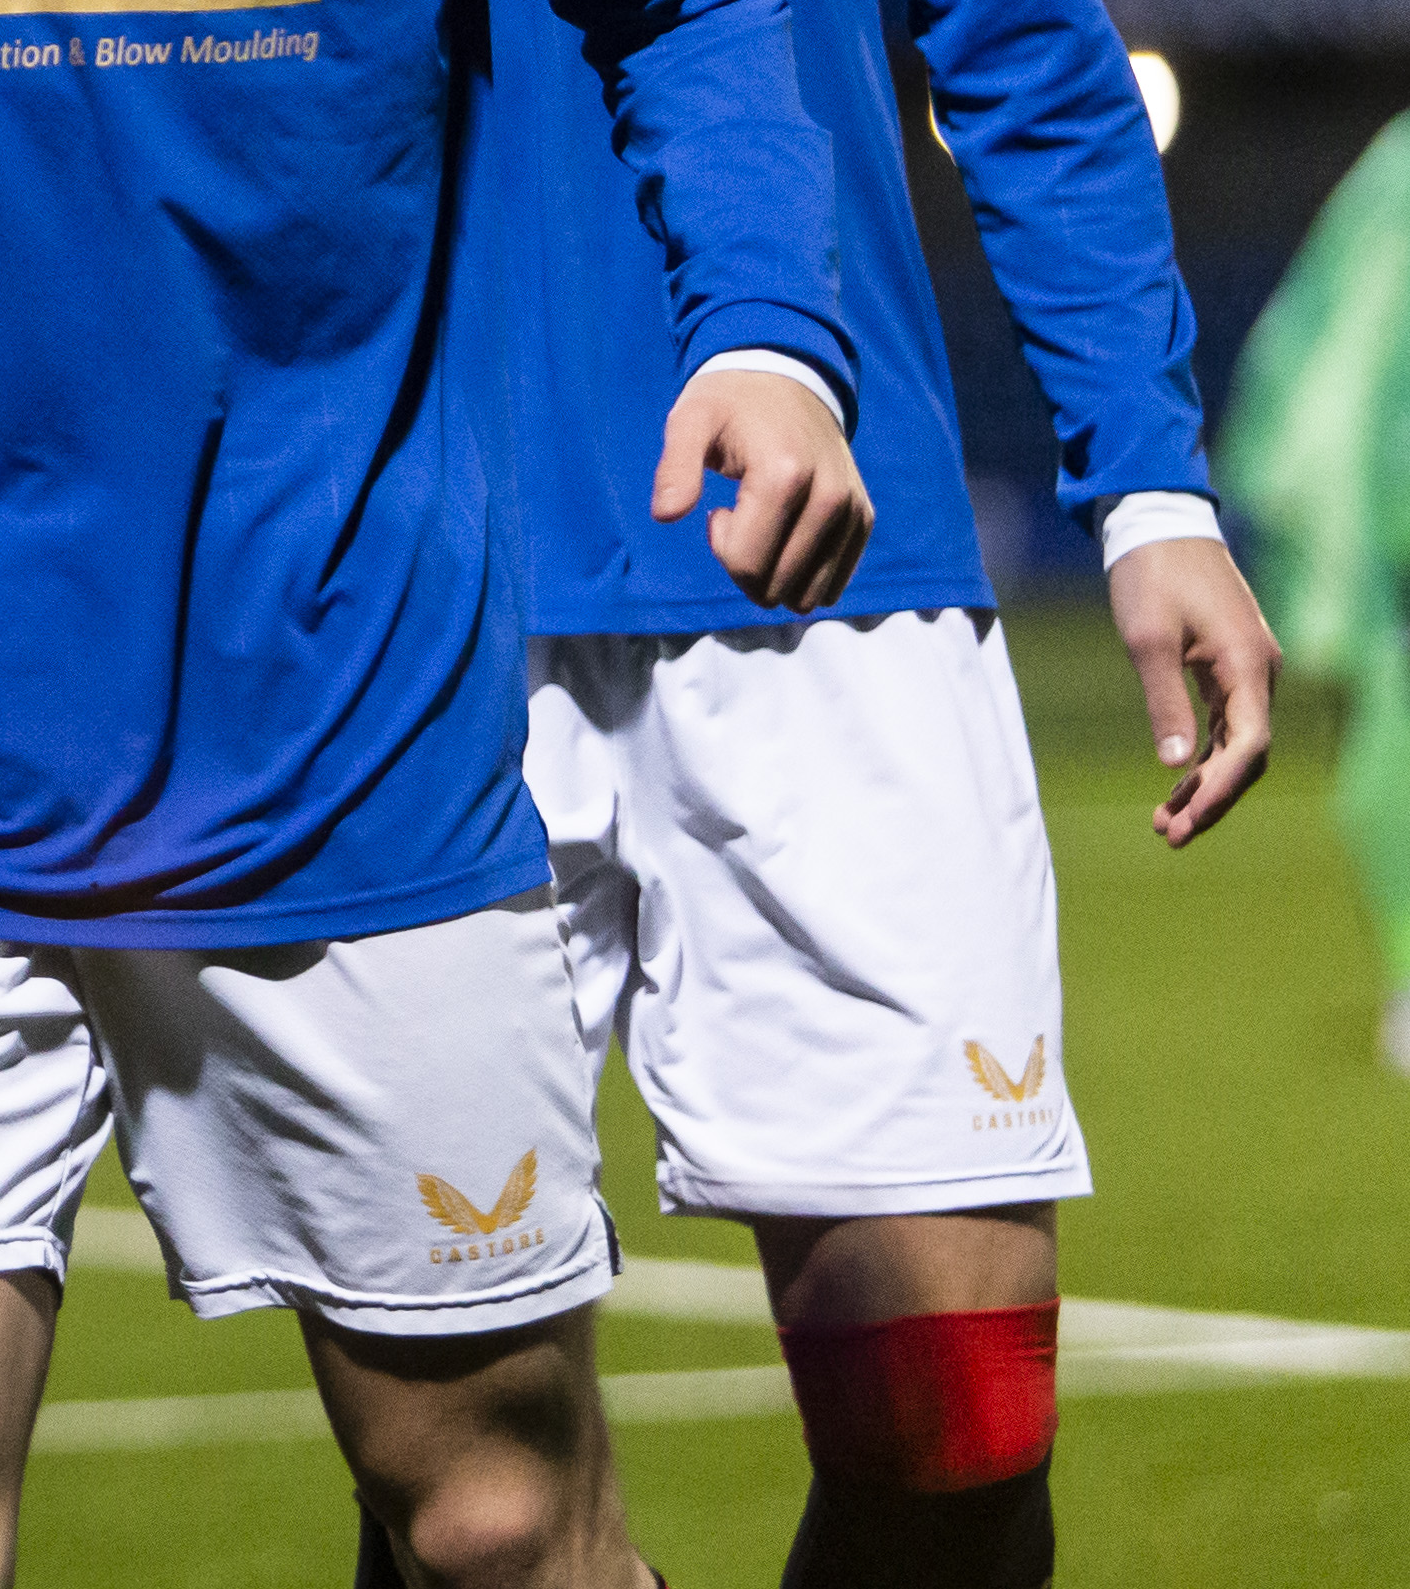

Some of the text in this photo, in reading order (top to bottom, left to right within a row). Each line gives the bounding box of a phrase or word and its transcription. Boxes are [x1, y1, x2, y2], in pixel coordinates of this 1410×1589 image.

[68, 37, 86, 67] &
[95, 35, 173, 68] Blow
[181, 28, 320, 64] Moulding
[429, 1227, 545, 1265] CASTORE
